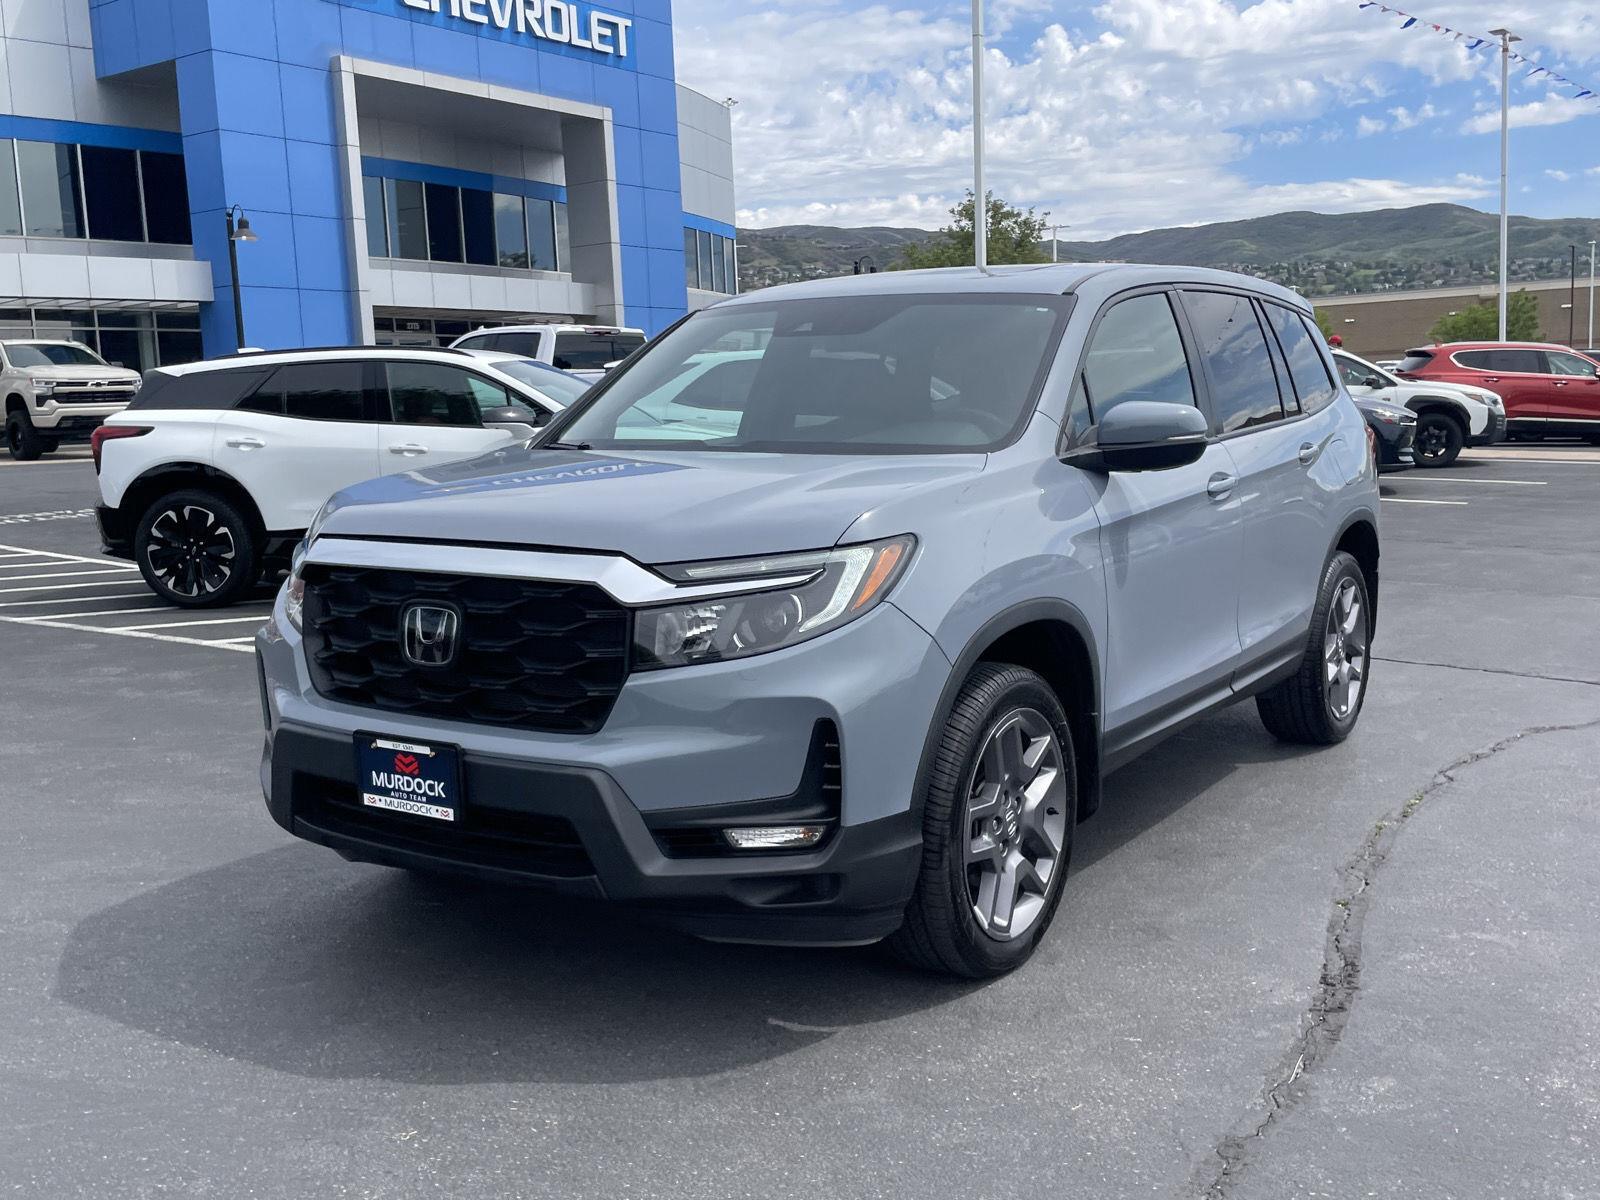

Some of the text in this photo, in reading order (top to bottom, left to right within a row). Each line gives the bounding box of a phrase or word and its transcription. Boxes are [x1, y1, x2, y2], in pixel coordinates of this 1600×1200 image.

[402, 0, 632, 57] EVROLET
[371, 770, 446, 798] MURDOCK
[384, 798, 432, 815] MURDOCK
[390, 790, 427, 803] AUTO TEAM
